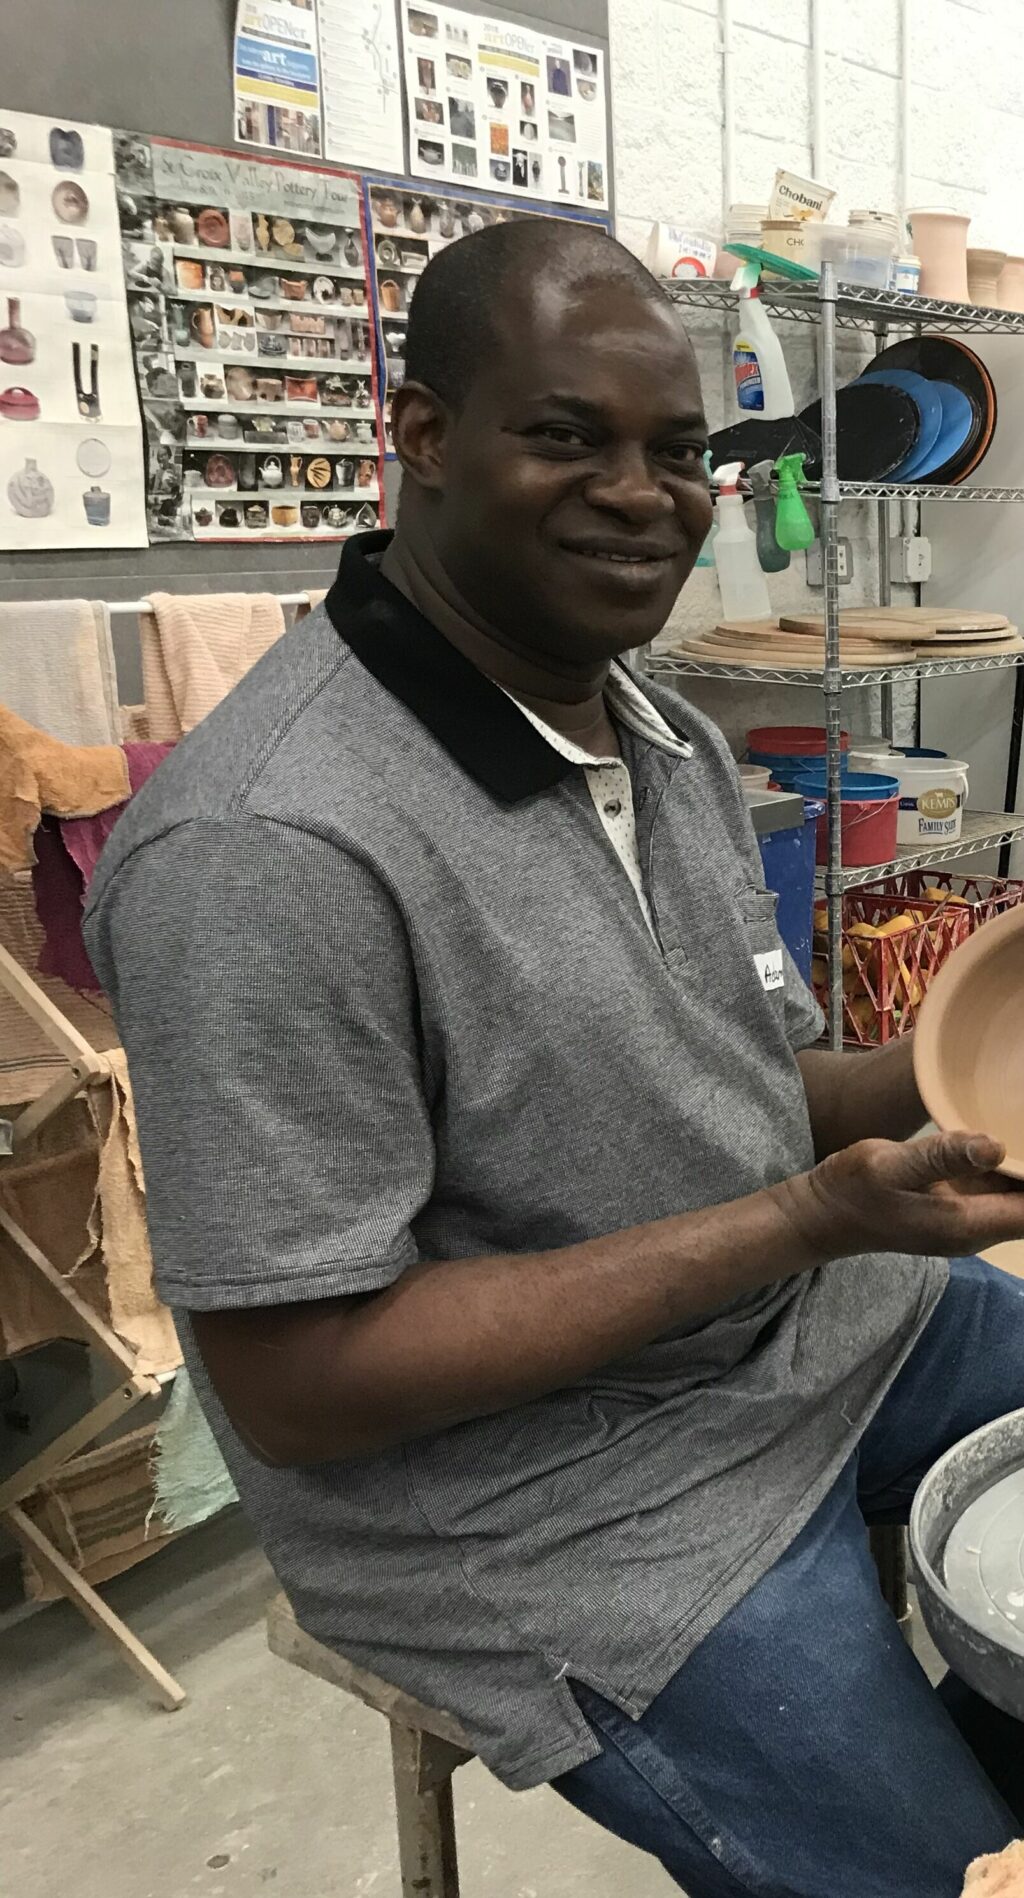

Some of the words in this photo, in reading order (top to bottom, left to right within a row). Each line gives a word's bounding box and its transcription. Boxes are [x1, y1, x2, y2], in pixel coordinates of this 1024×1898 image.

[262, 50, 287, 66] art
[779, 184, 823, 211] Chobani
[918, 817, 943, 833] FAMILY
